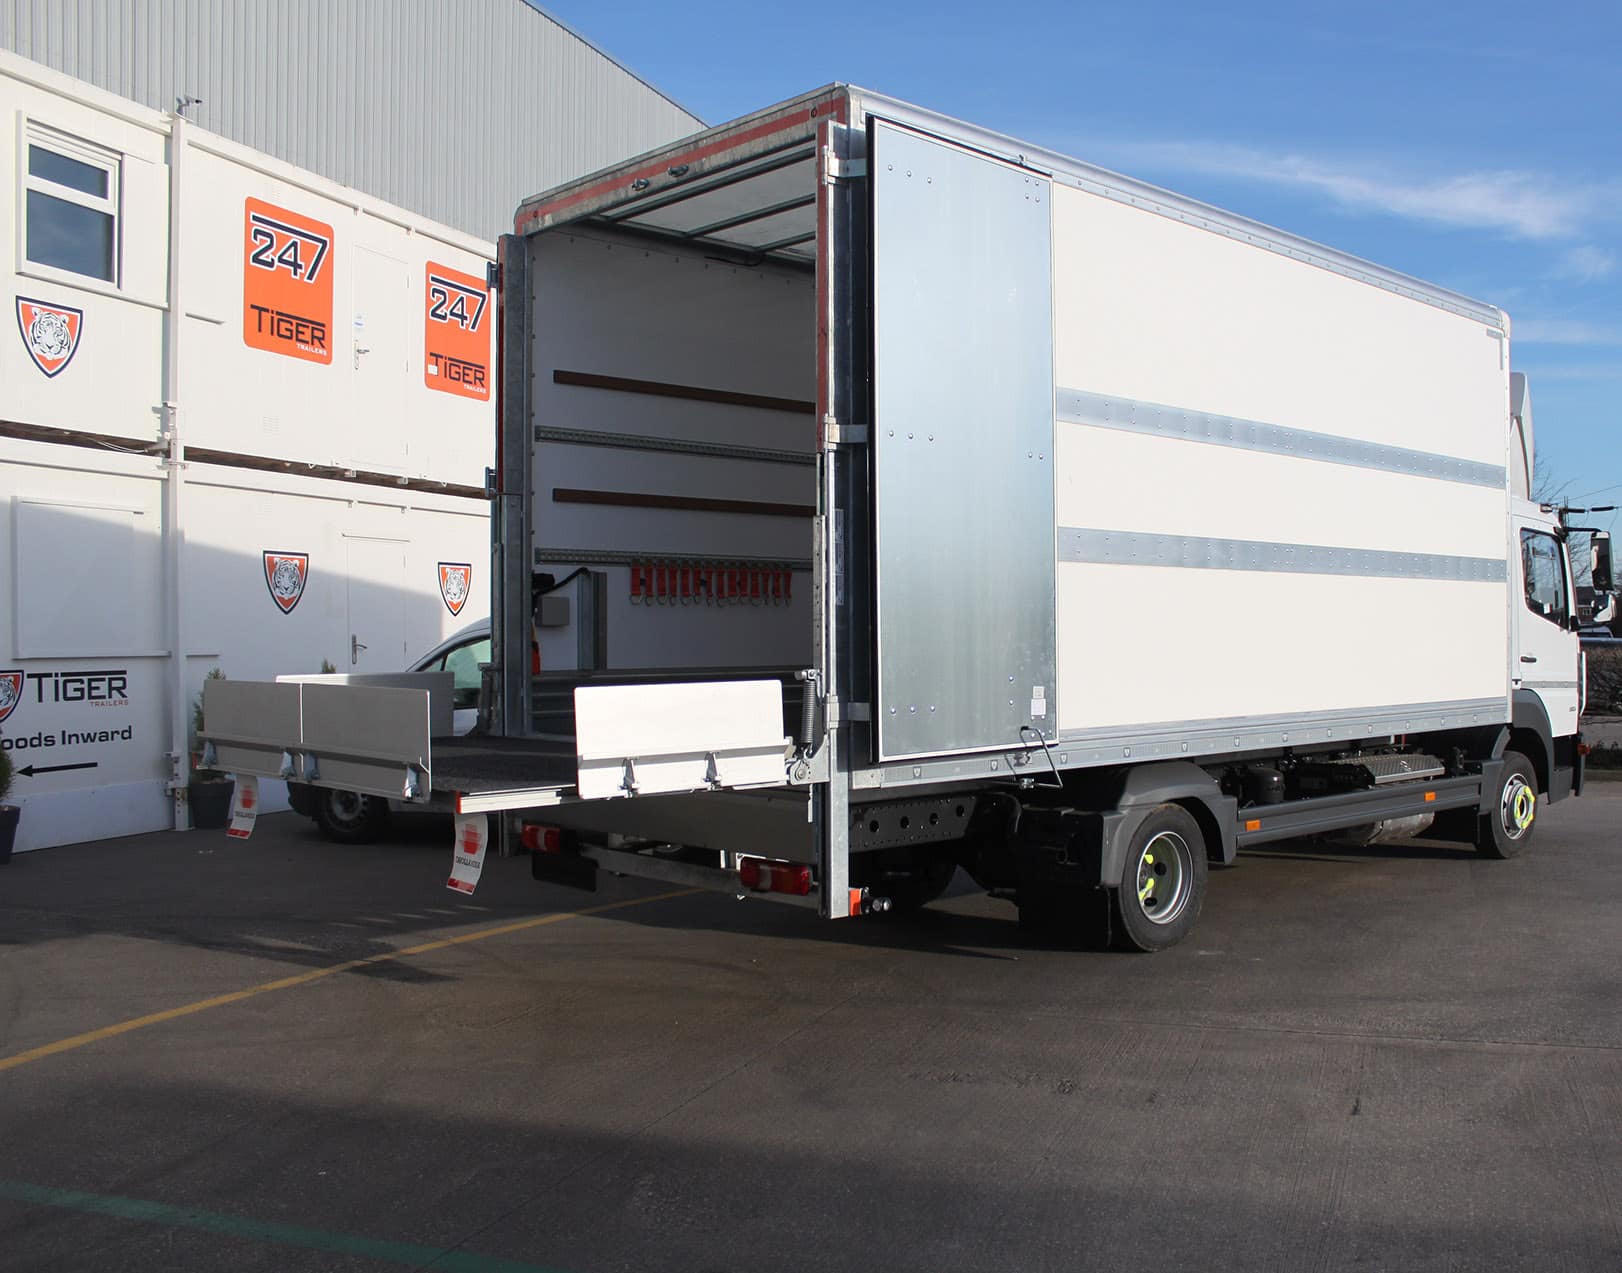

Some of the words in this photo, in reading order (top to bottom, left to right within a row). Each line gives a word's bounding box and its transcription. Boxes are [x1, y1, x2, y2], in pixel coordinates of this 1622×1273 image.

[251, 211, 329, 283] 247
[430, 275, 488, 332] 247
[297, 343, 328, 356] TRAILERS
[90, 700, 129, 708] TRAILERS
[0, 732, 56, 751] oods
[61, 725, 132, 745] Inward
